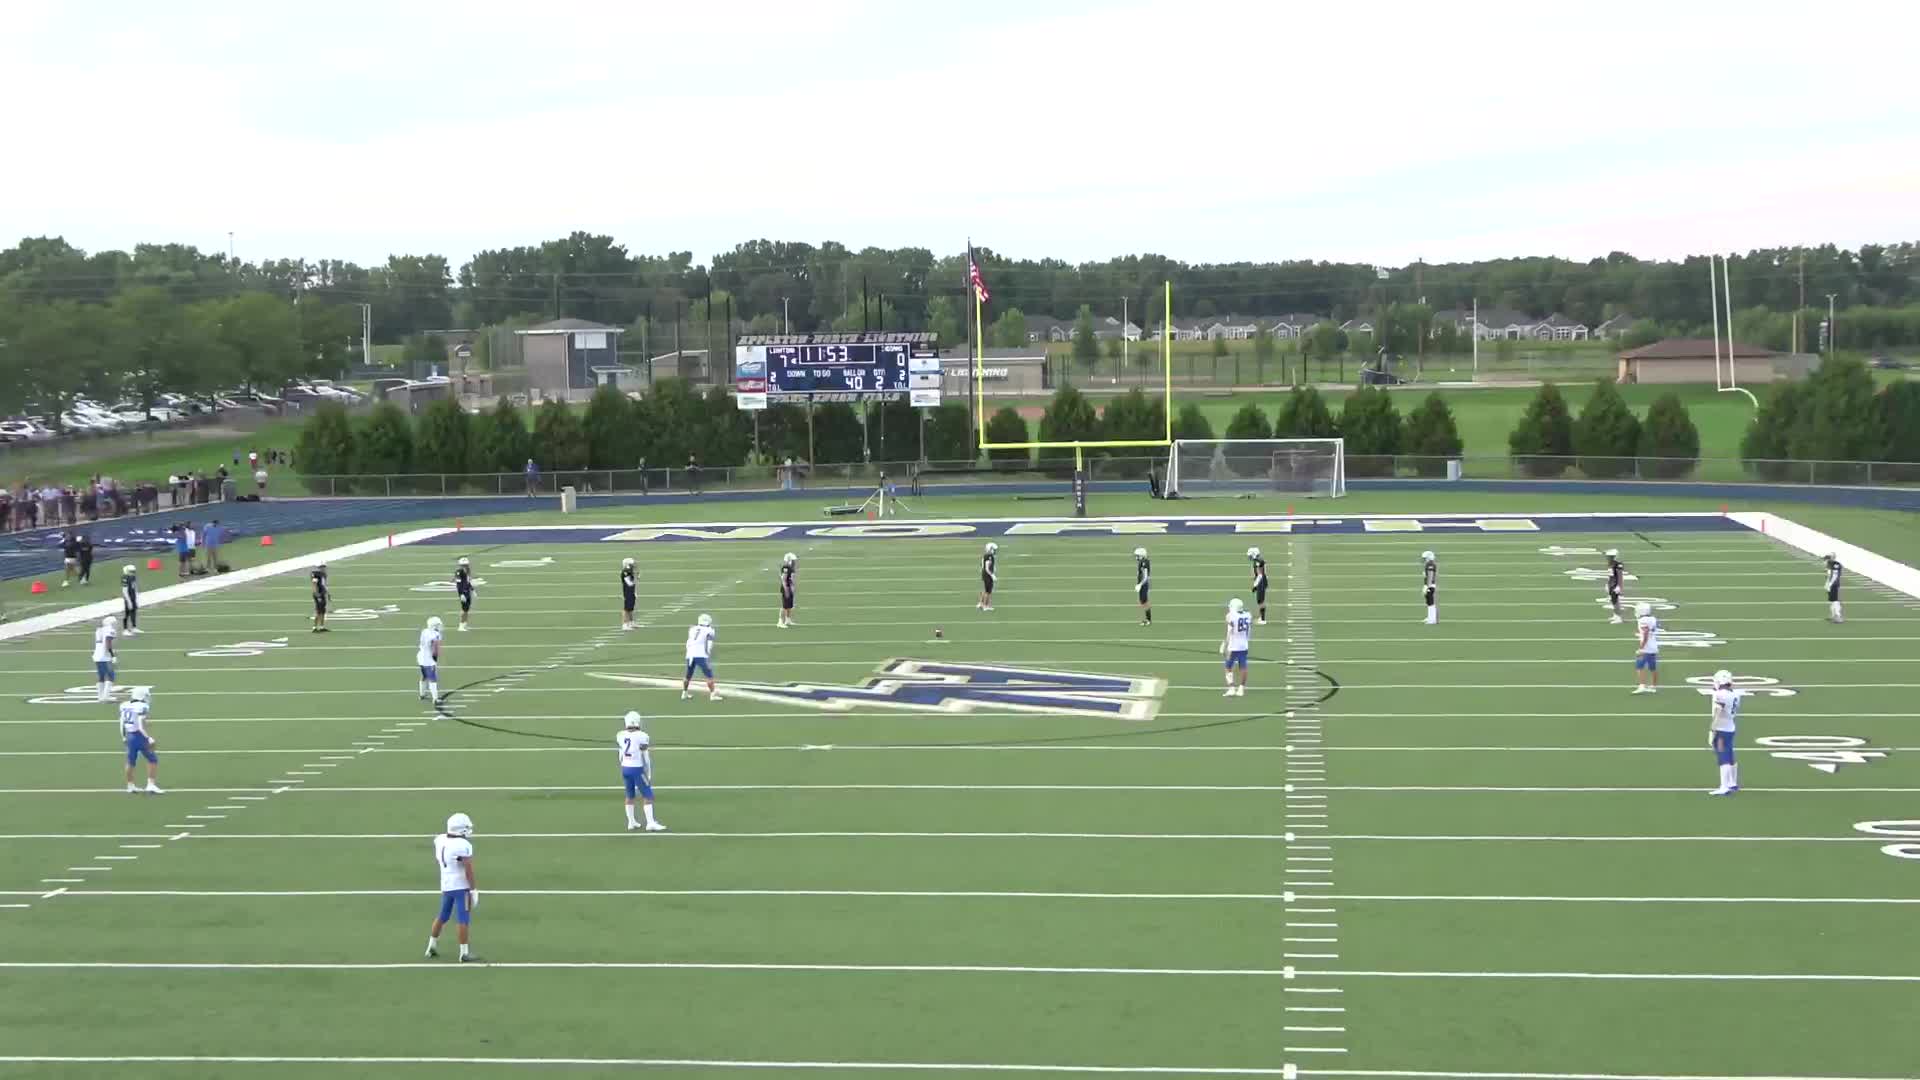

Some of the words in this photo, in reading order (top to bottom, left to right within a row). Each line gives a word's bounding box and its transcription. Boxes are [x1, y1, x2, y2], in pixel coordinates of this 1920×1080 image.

[806, 345, 848, 361] 11:53
[897, 353, 905, 366] 0
[780, 354, 787, 368] 7
[770, 371, 777, 383] 2
[899, 369, 906, 381] 2
[845, 376, 863, 390] 40
[875, 375, 884, 390] 2
[600, 520, 1541, 541] NORTH
